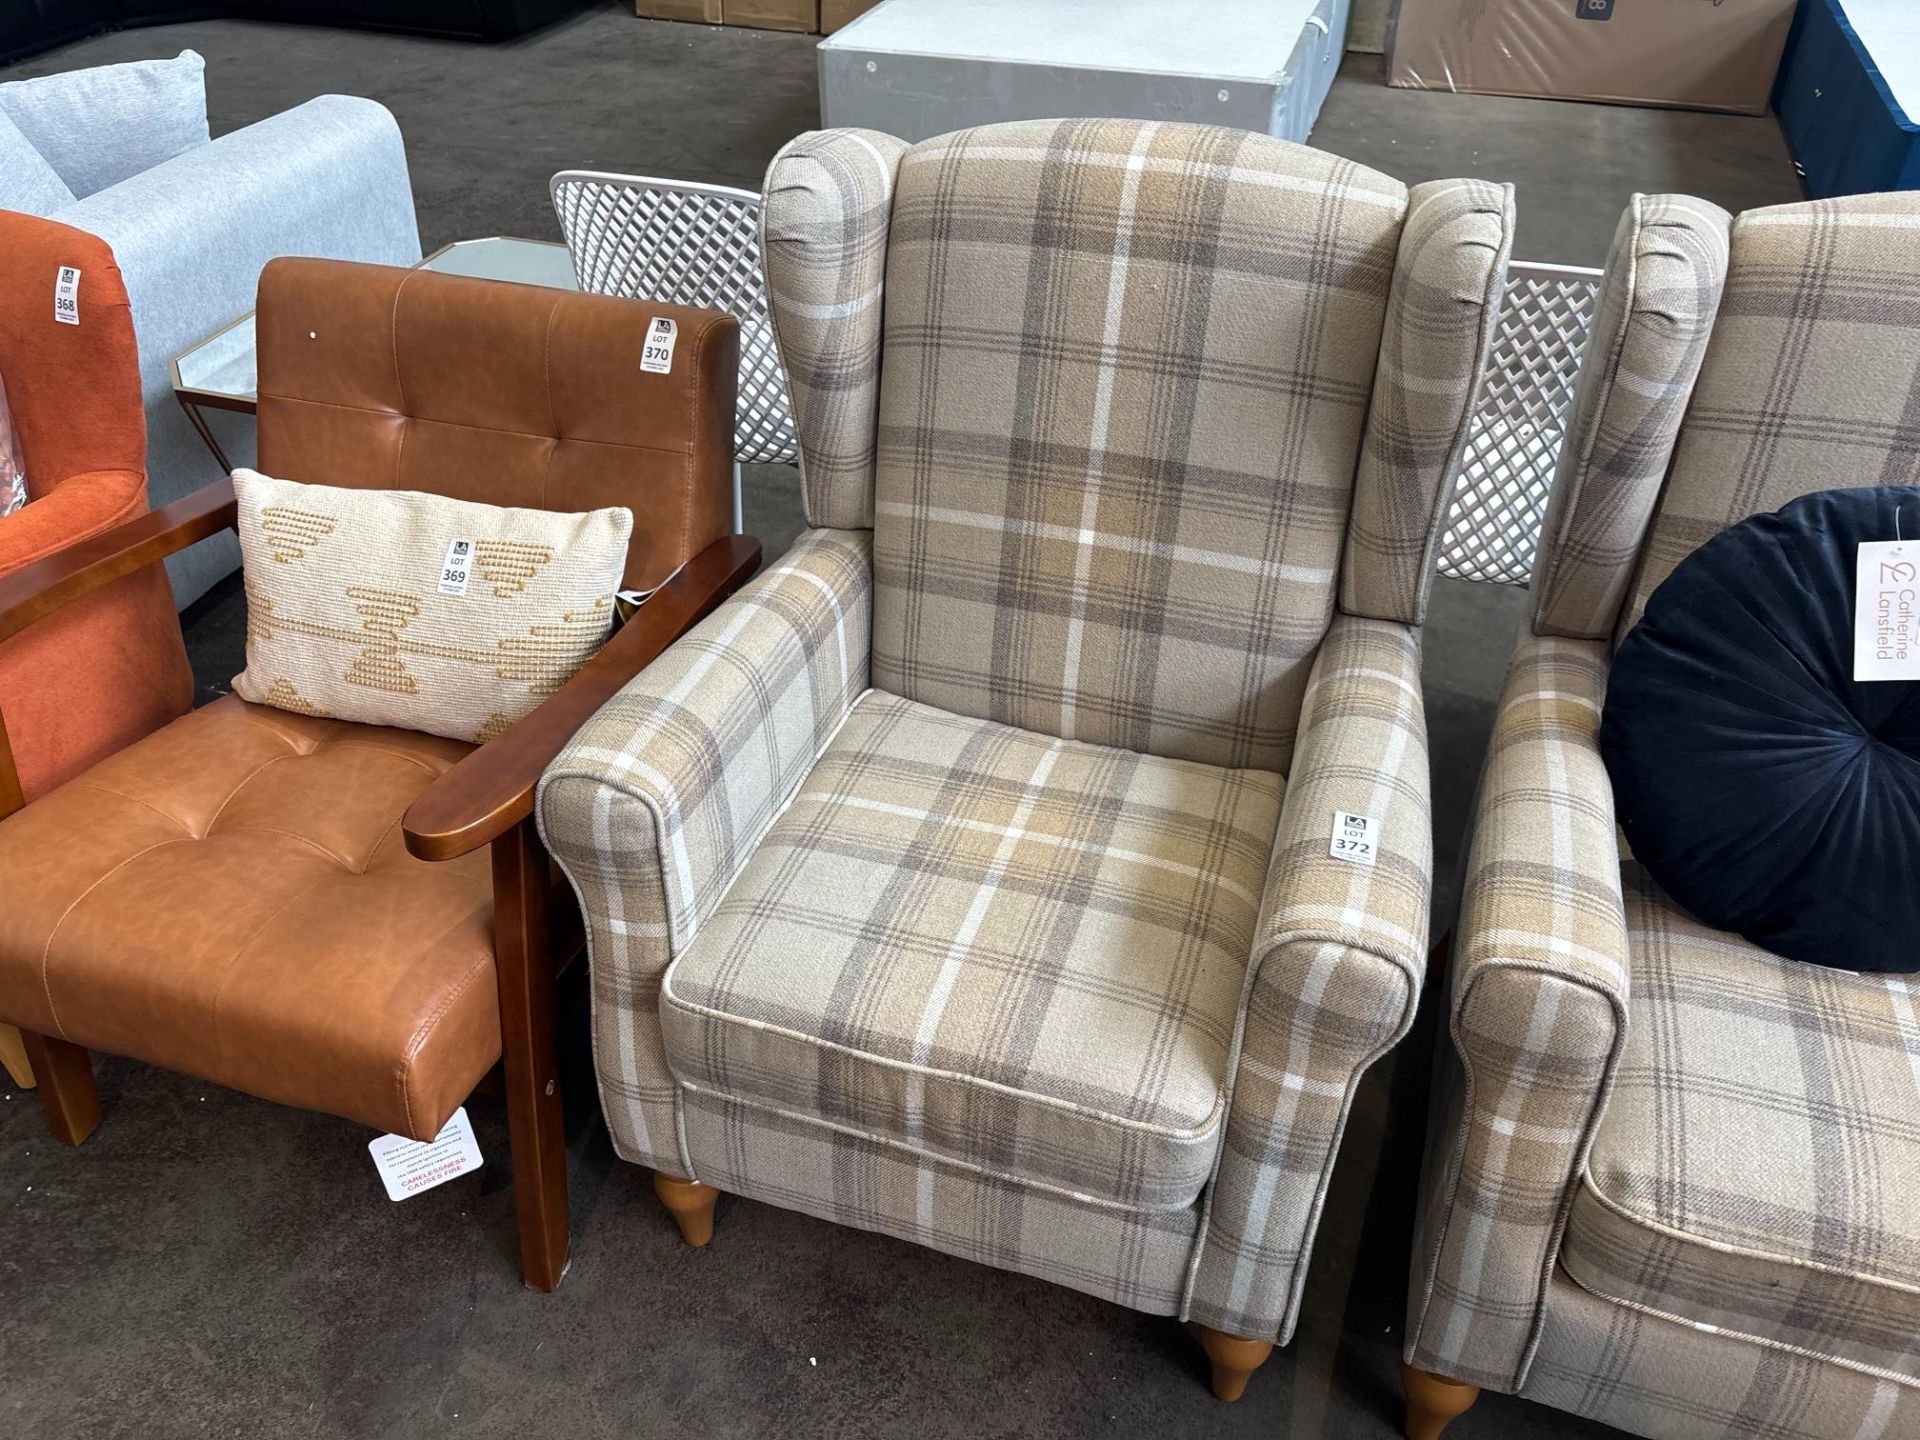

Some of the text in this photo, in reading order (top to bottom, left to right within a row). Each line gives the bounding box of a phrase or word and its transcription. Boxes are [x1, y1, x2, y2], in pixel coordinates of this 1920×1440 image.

[57, 298, 75, 311] 368
[653, 335, 668, 343] LOT
[645, 347, 669, 361] 370
[443, 569, 466, 583] 369
[1876, 591, 1896, 660] Lansfield
[1896, 589, 1916, 660] Catherine
[1344, 830, 1364, 838] LOT
[1335, 838, 1370, 855] 372
[400, 1156, 466, 1187] CARELESSNESS
[407, 1164, 462, 1191] CAUSES FIRE
